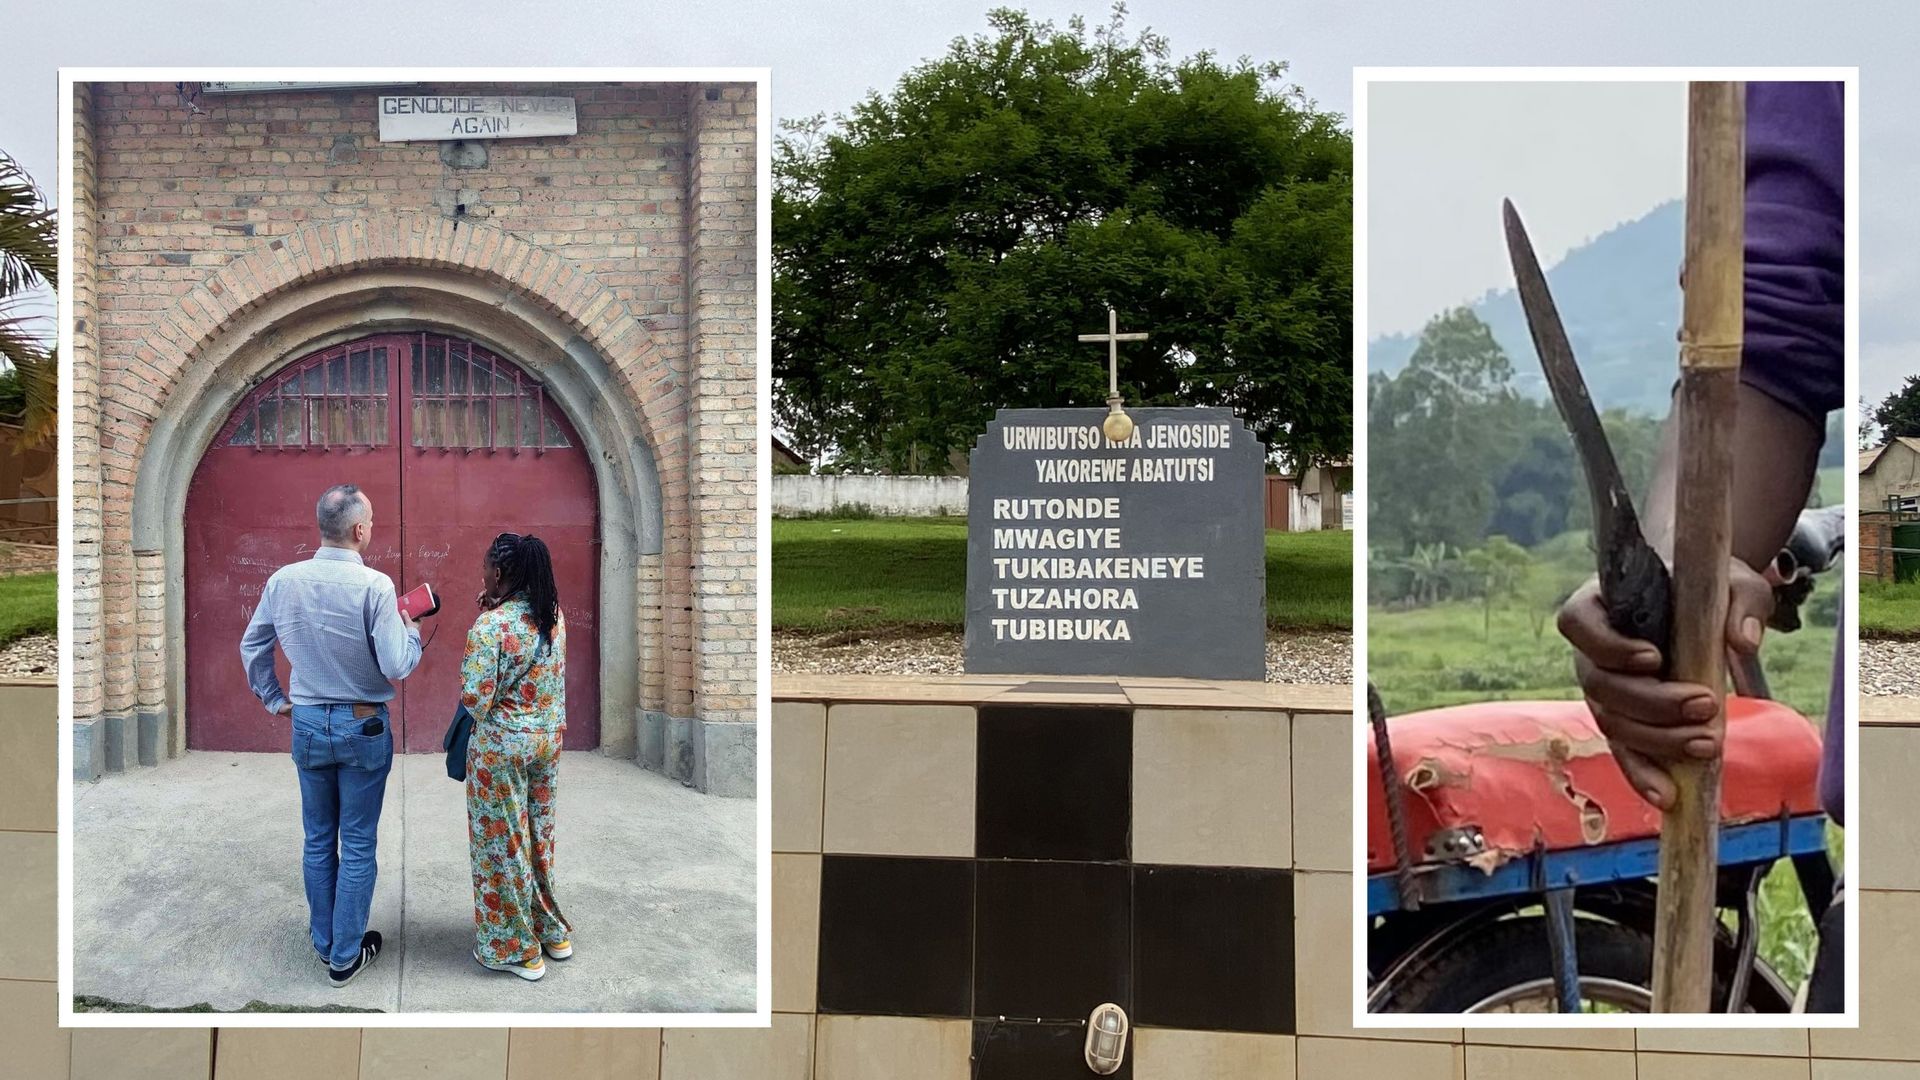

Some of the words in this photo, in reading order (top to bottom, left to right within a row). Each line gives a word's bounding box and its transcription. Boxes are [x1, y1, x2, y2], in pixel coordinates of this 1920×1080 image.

[383, 97, 485, 115] GENOCIDE
[451, 116, 510, 134] AGAIN
[1003, 426, 1099, 449] URWIBUTSO
[1147, 424, 1230, 448] JENOSIDE
[1036, 459, 1126, 482] YAKOREWE
[1131, 458, 1213, 482] ABATUTSI
[994, 498, 1120, 519] RUTONDE
[994, 528, 1120, 549] MWAGIYE
[994, 557, 1203, 579] TUKIBAKENEYE
[992, 588, 1138, 609] TUZAHORA
[992, 619, 1130, 640] TUBIBUKA
